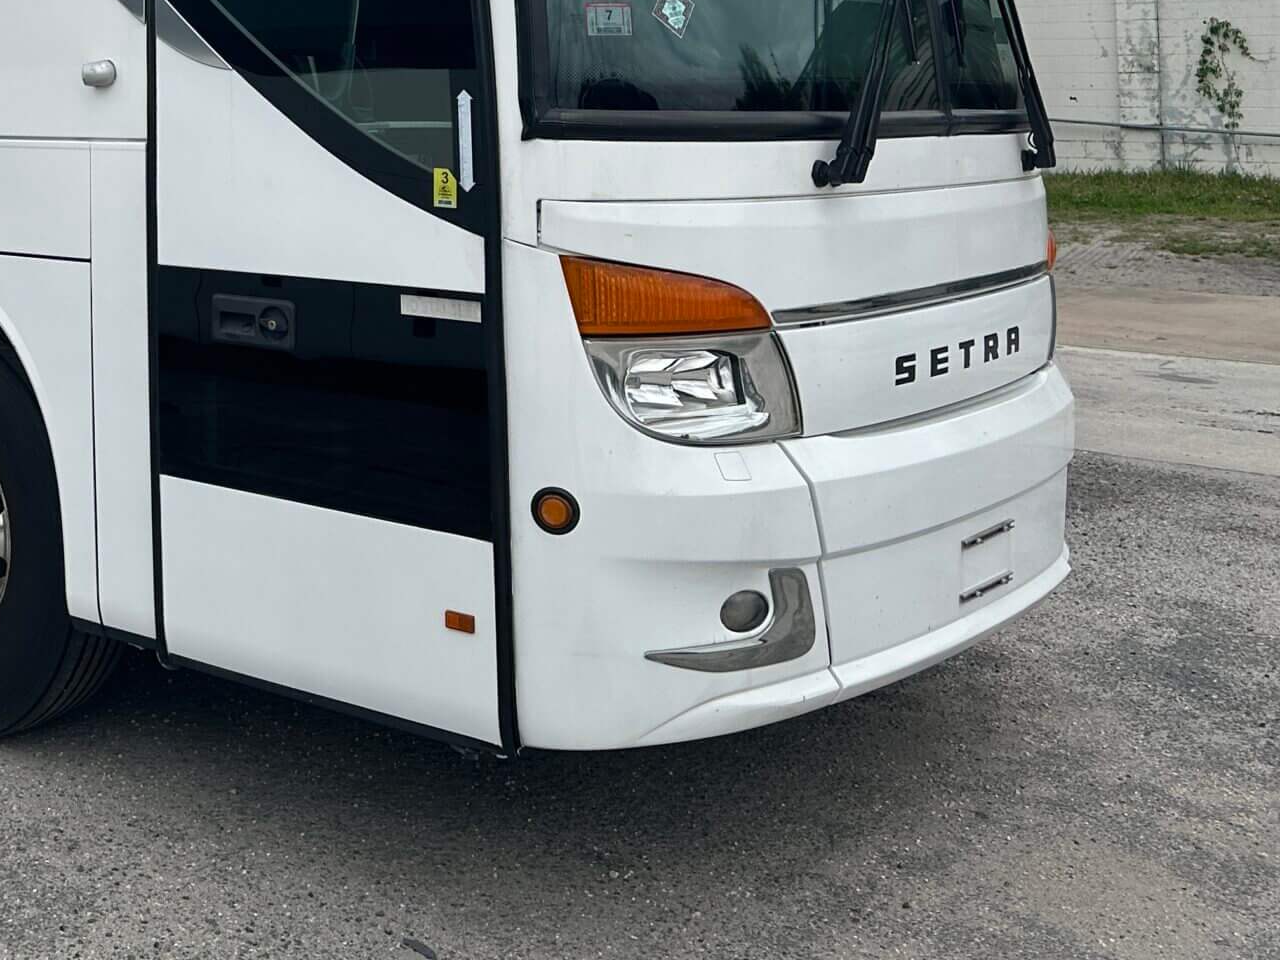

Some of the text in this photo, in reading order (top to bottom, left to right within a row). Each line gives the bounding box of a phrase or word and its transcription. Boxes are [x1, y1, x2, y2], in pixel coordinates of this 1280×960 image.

[605, 9, 613, 21] 7
[441, 171, 449, 184] 3
[895, 325, 1020, 386] SETRA
